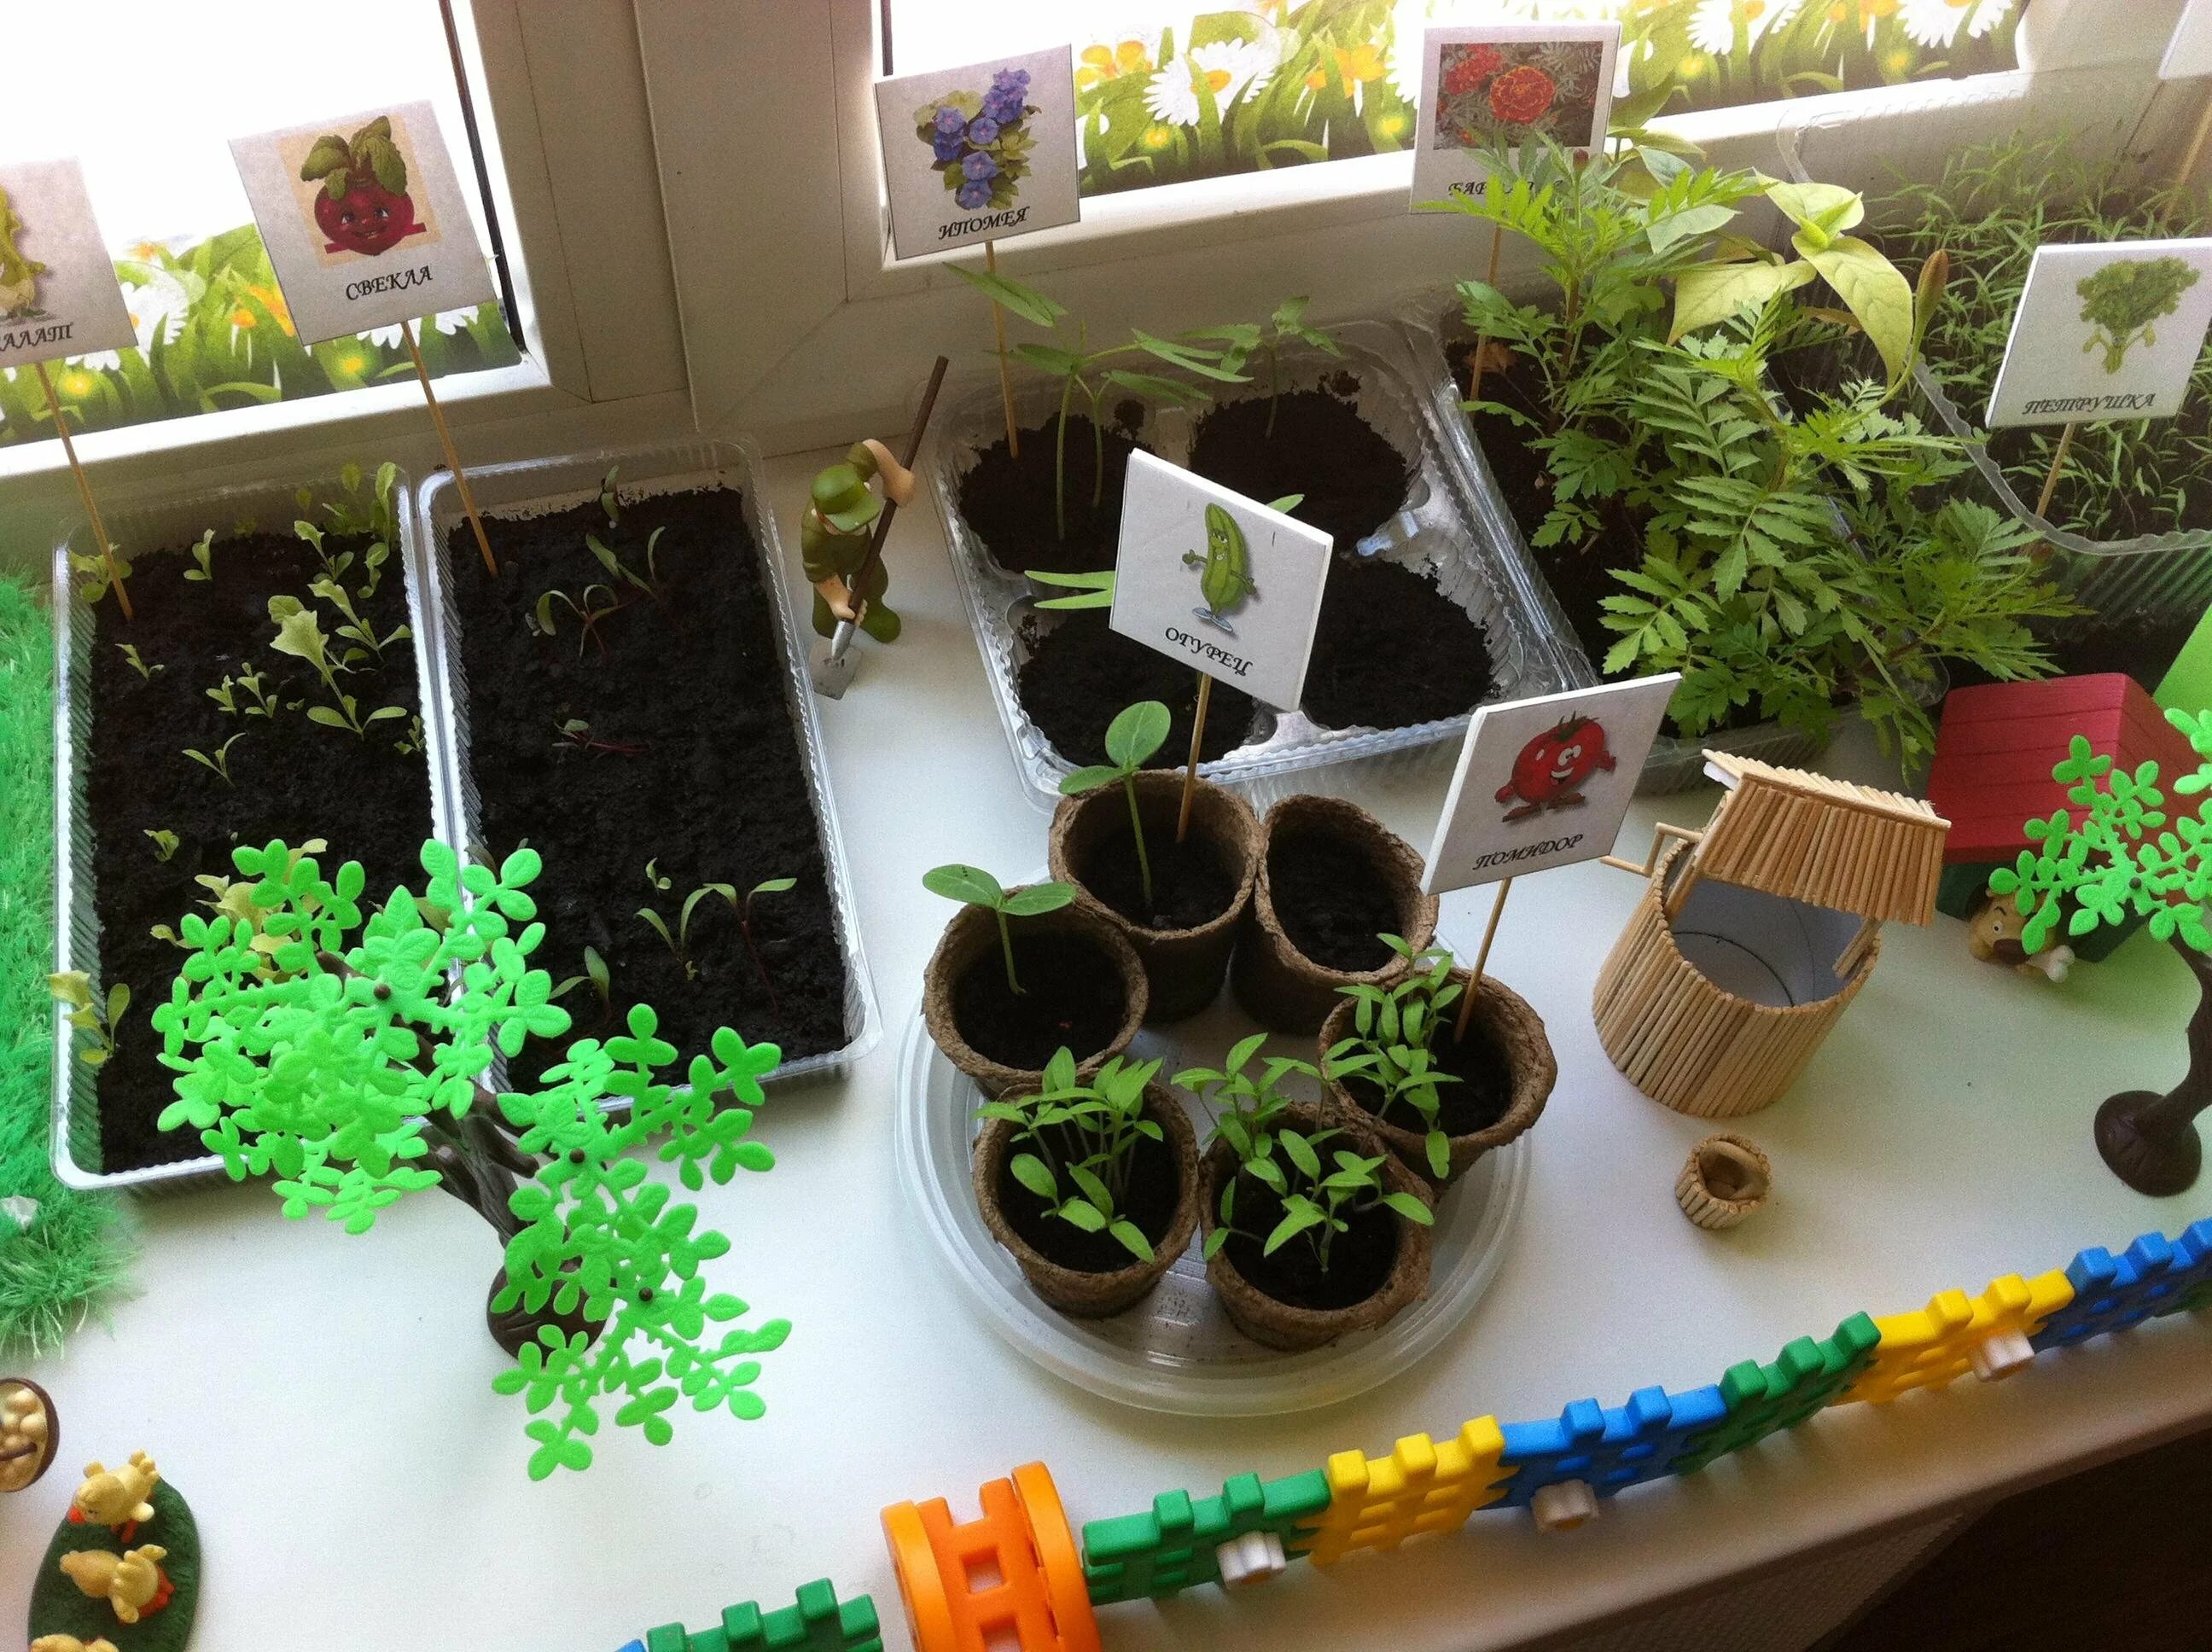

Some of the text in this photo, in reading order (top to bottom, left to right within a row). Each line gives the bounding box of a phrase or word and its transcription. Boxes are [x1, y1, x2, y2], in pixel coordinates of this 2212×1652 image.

[938, 206, 1031, 240] ИПОМЕЯ
[346, 265, 434, 300] СВЕКЛА
[0, 322, 74, 352] АЛАТ
[2022, 393, 2157, 415] ПЕТРУШКА
[1165, 627, 1254, 677] ОГУРЕЦ
[1472, 834, 1584, 870] ПОМИДОР
